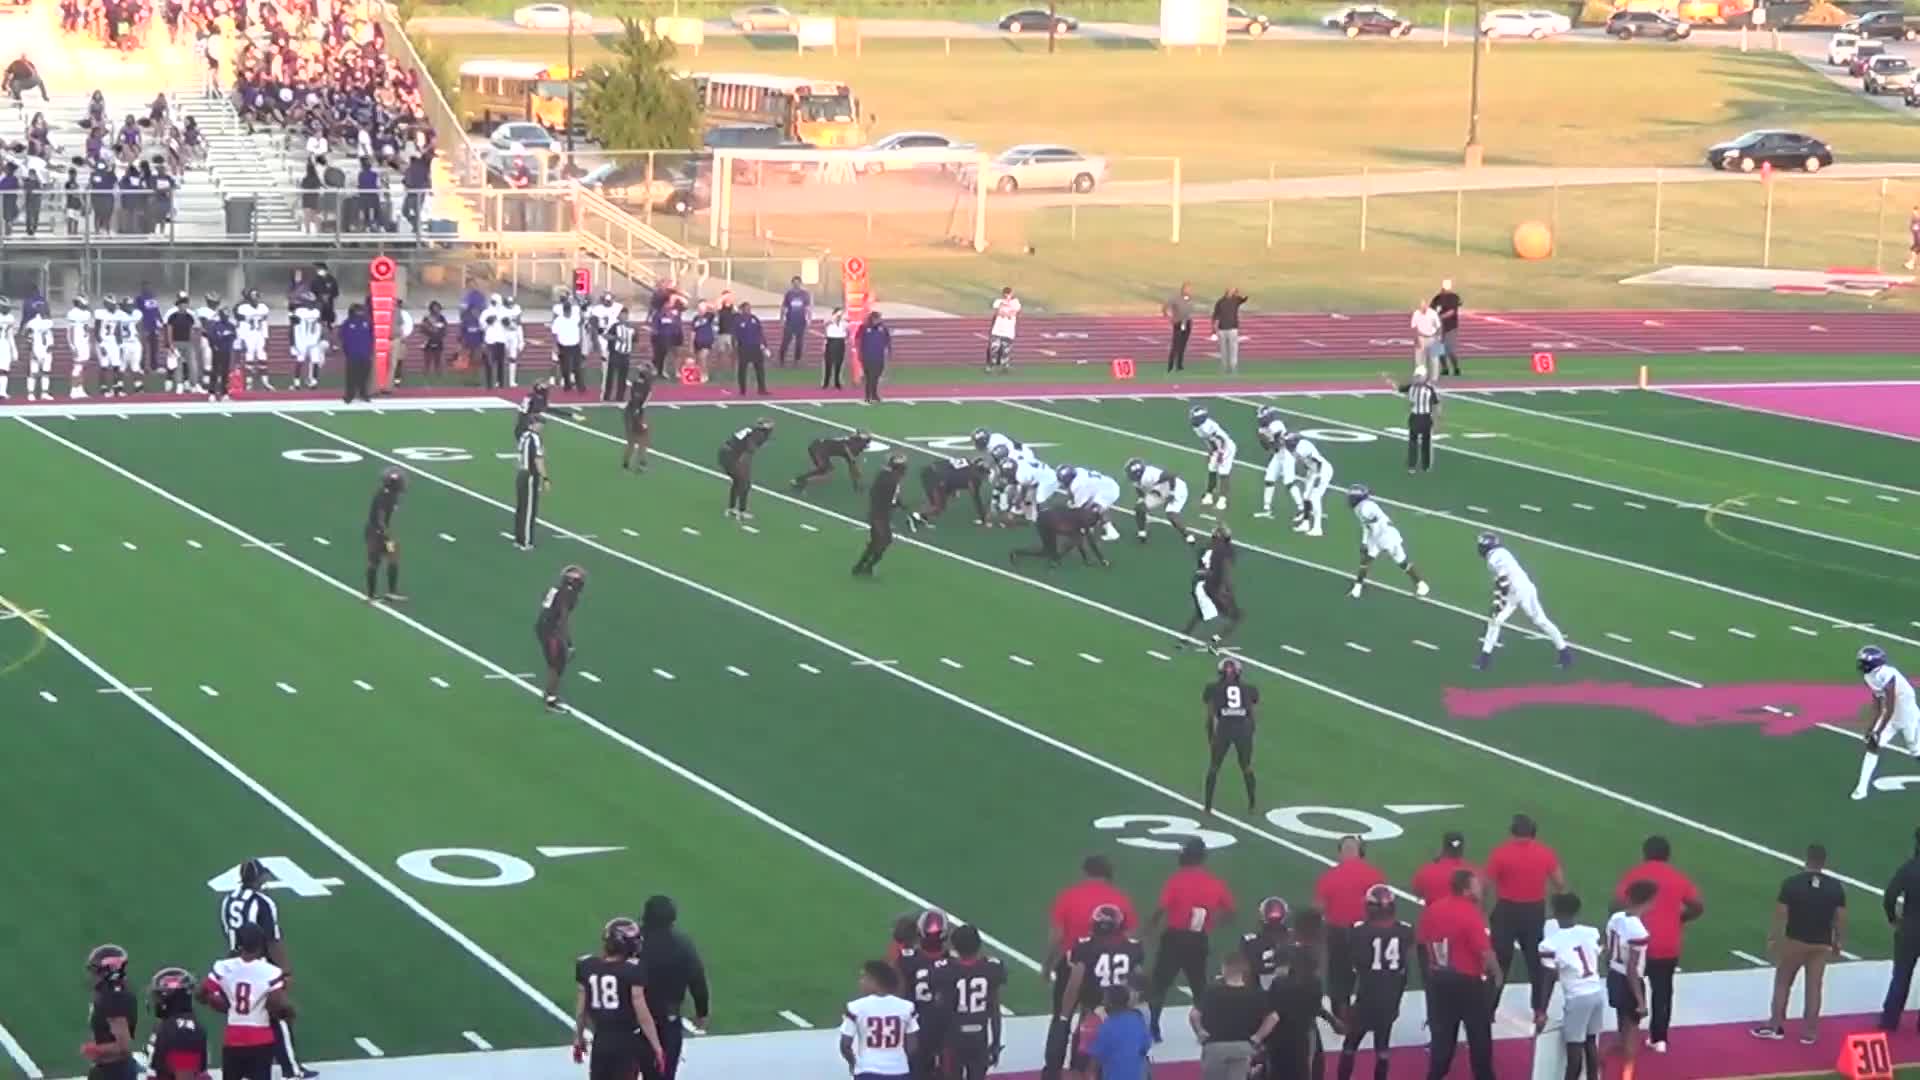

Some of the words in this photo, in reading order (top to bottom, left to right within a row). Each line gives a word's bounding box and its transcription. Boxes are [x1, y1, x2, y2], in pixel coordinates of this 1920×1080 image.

[1226, 685, 1241, 708] 9
[230, 901, 245, 928] S
[1094, 953, 1130, 987] 42
[1371, 937, 1400, 971] 14
[1573, 945, 1594, 978] 1
[235, 981, 252, 1015] 8
[588, 973, 620, 1010] 18
[956, 977, 988, 1013] 12
[866, 1015, 902, 1049] 33
[1853, 1039, 1889, 1075] 30
